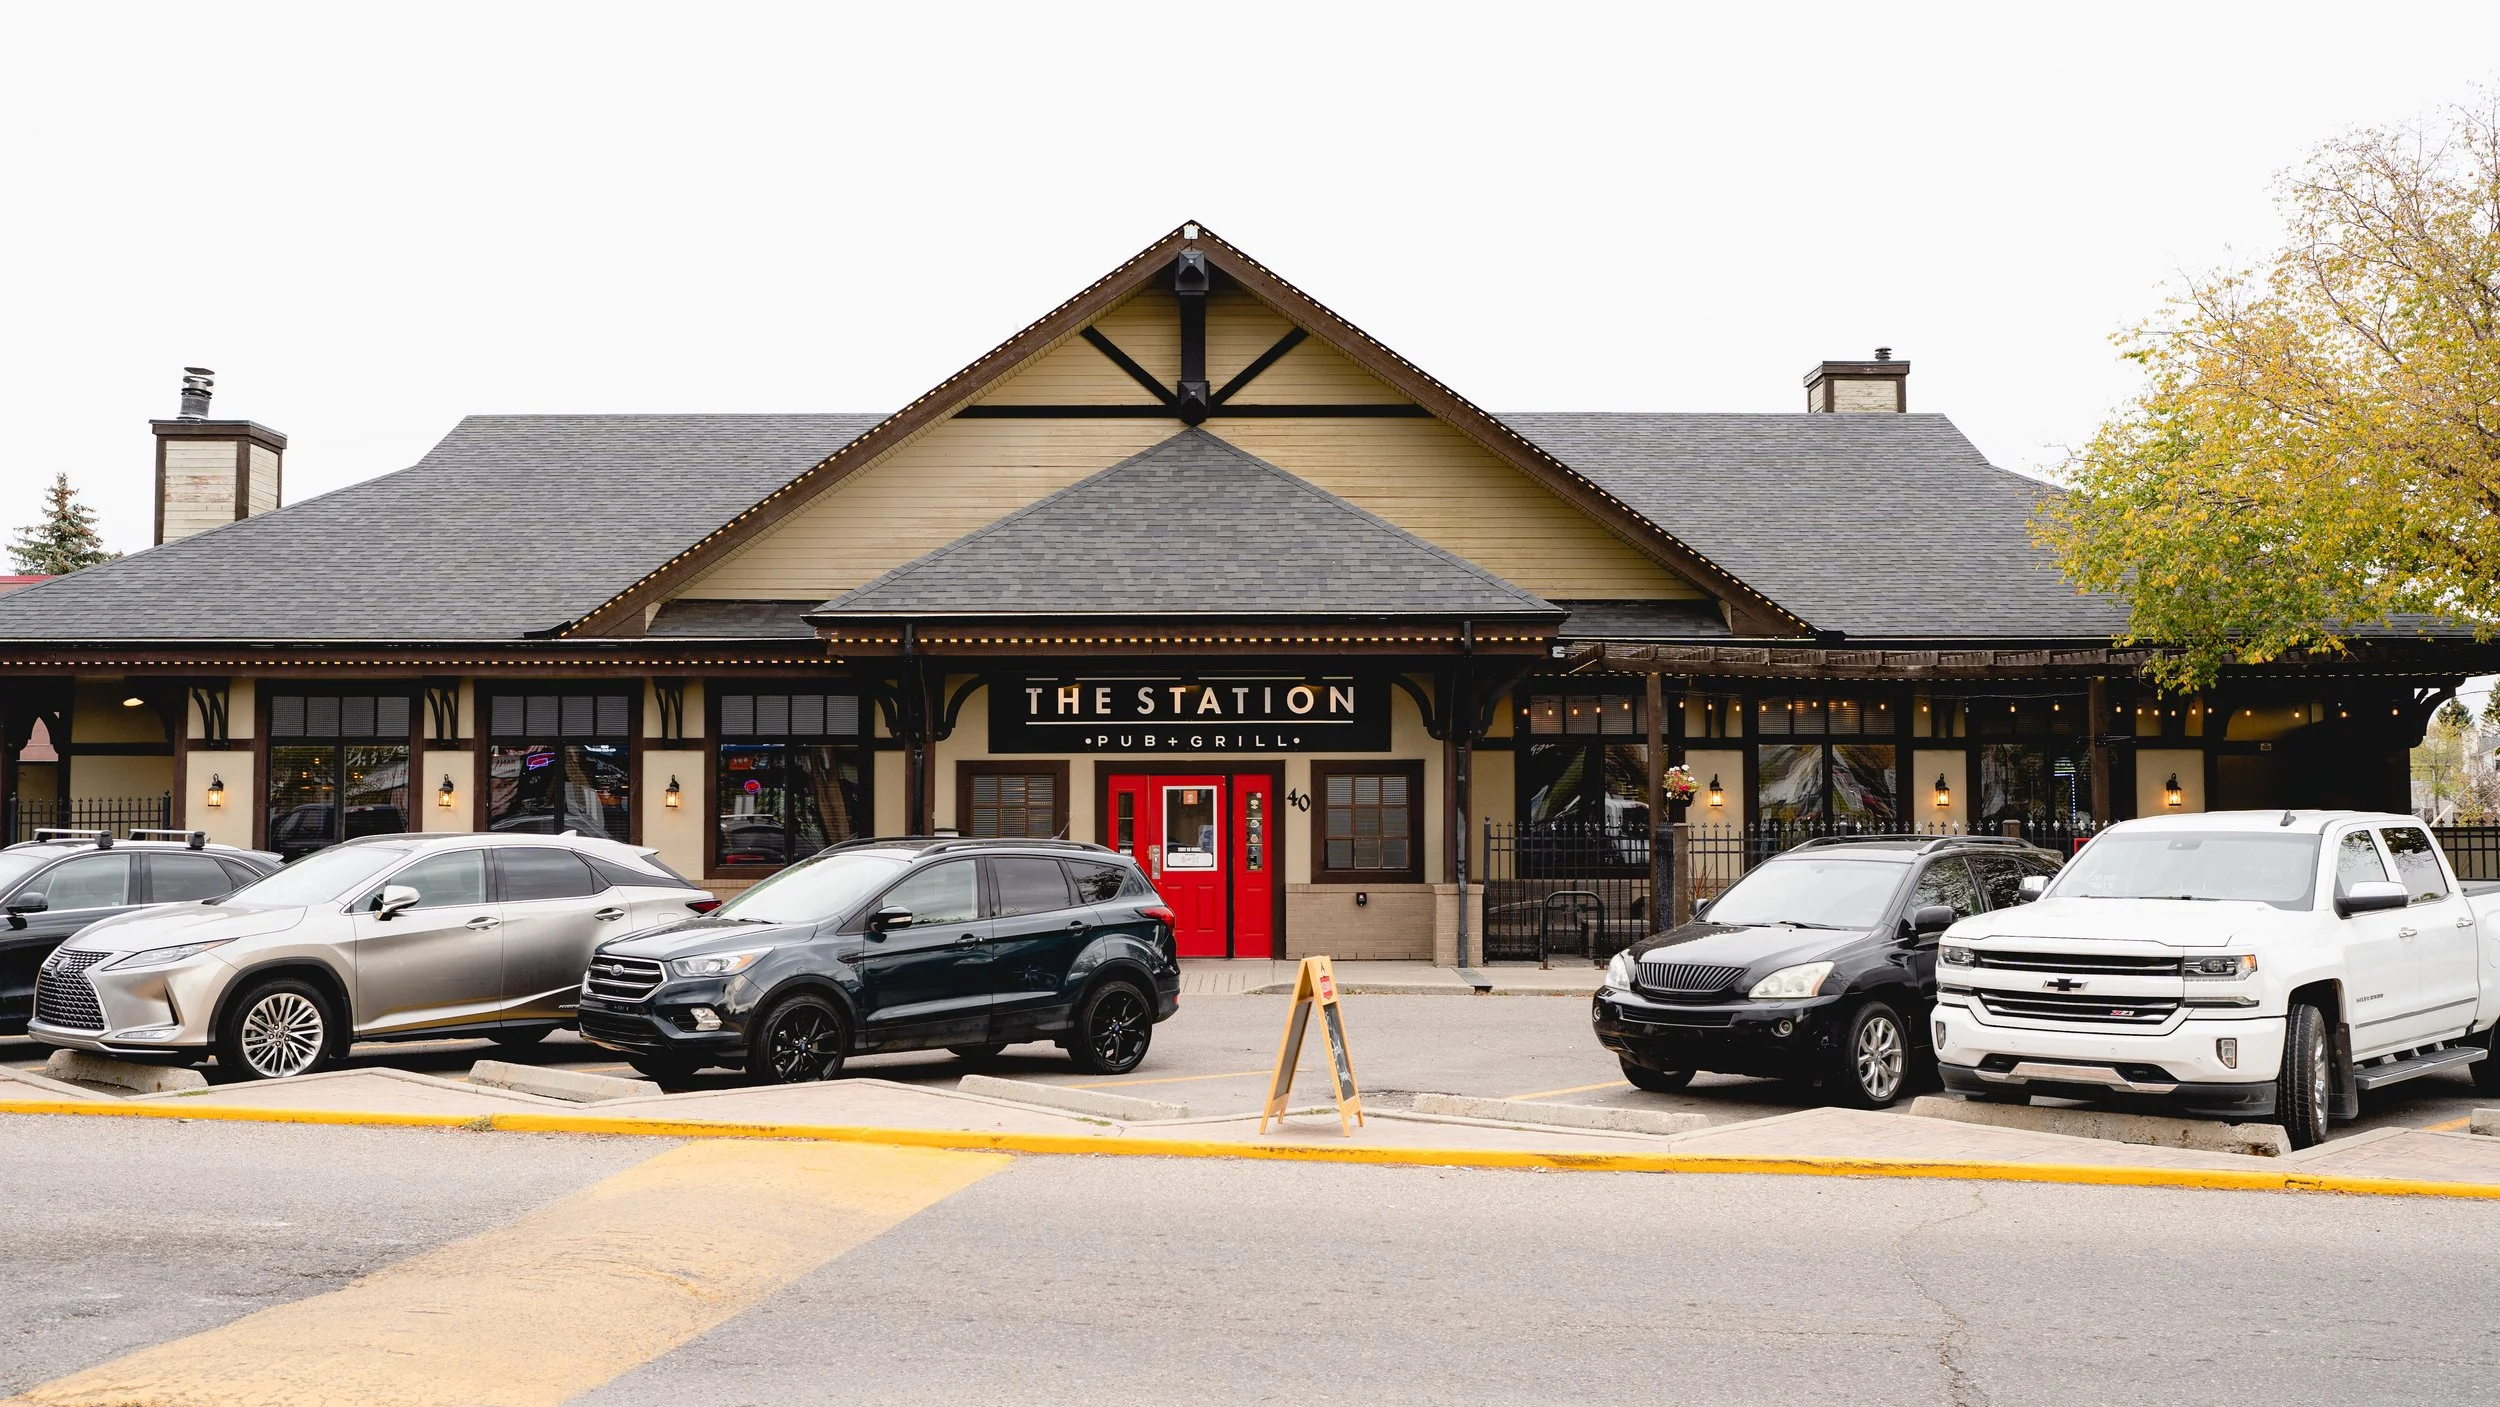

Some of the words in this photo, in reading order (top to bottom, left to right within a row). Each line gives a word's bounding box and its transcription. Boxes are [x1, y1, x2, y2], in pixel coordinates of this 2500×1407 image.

[1025, 687, 1112, 715] THE
[1136, 686, 1355, 715] STATION
[1286, 788, 1311, 813] 40
